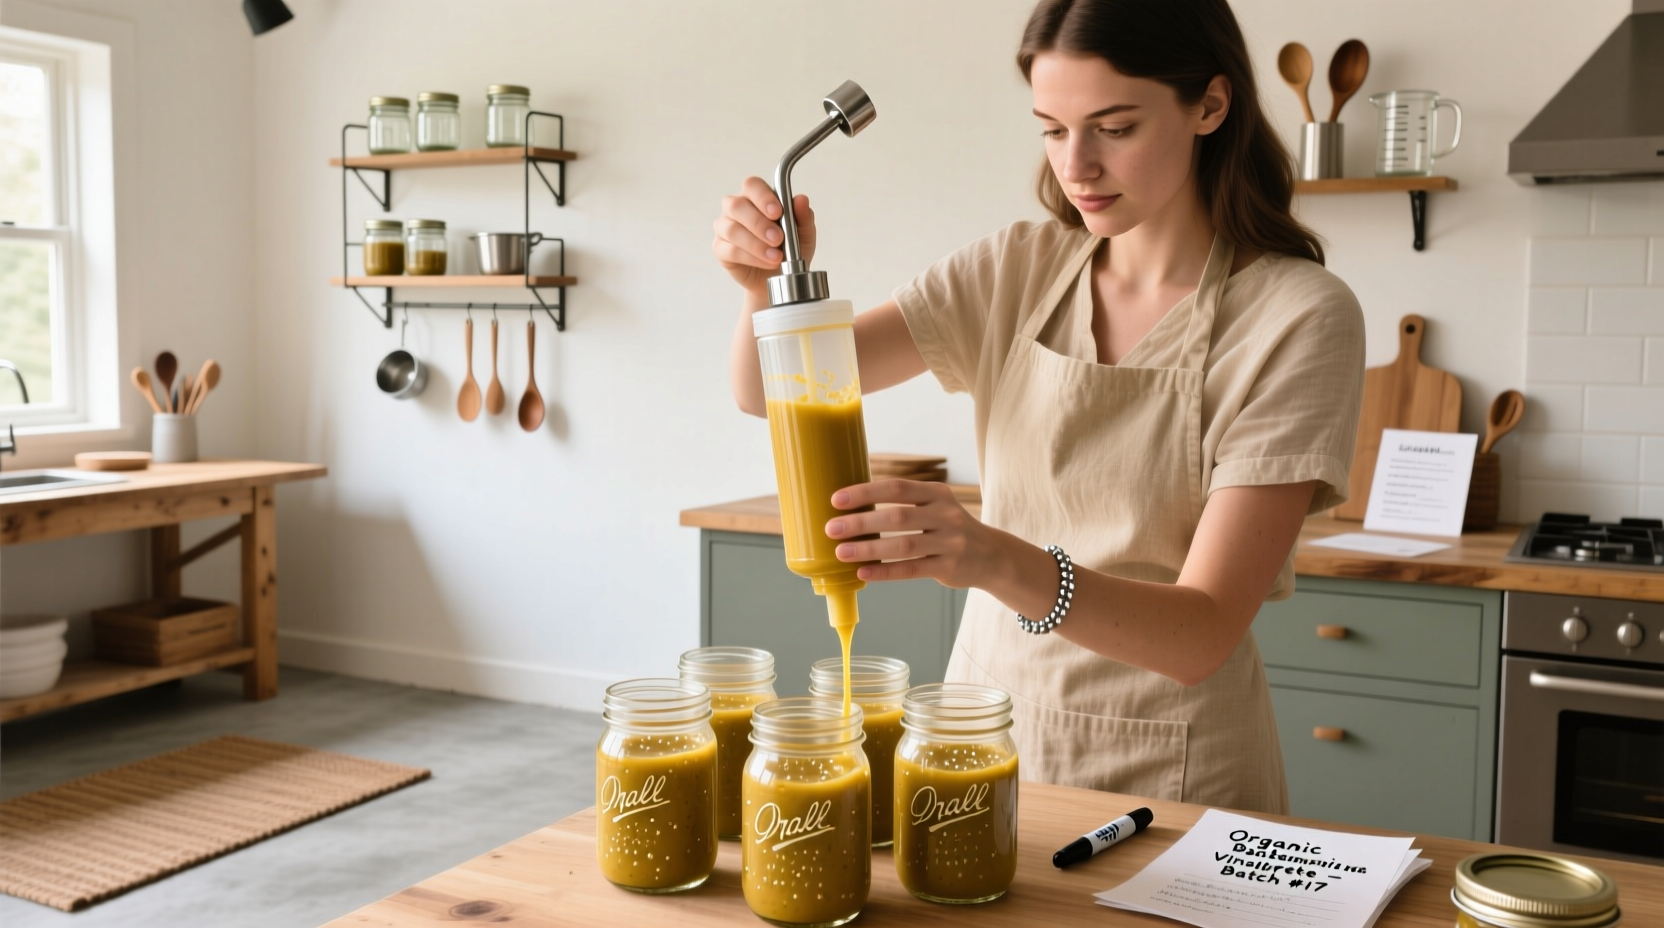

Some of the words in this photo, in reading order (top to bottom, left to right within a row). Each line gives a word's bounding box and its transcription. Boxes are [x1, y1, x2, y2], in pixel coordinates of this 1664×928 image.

[1229, 830, 1322, 855] Organic
[1220, 865, 1280, 885] Batch
[1288, 879, 1328, 892] #17
